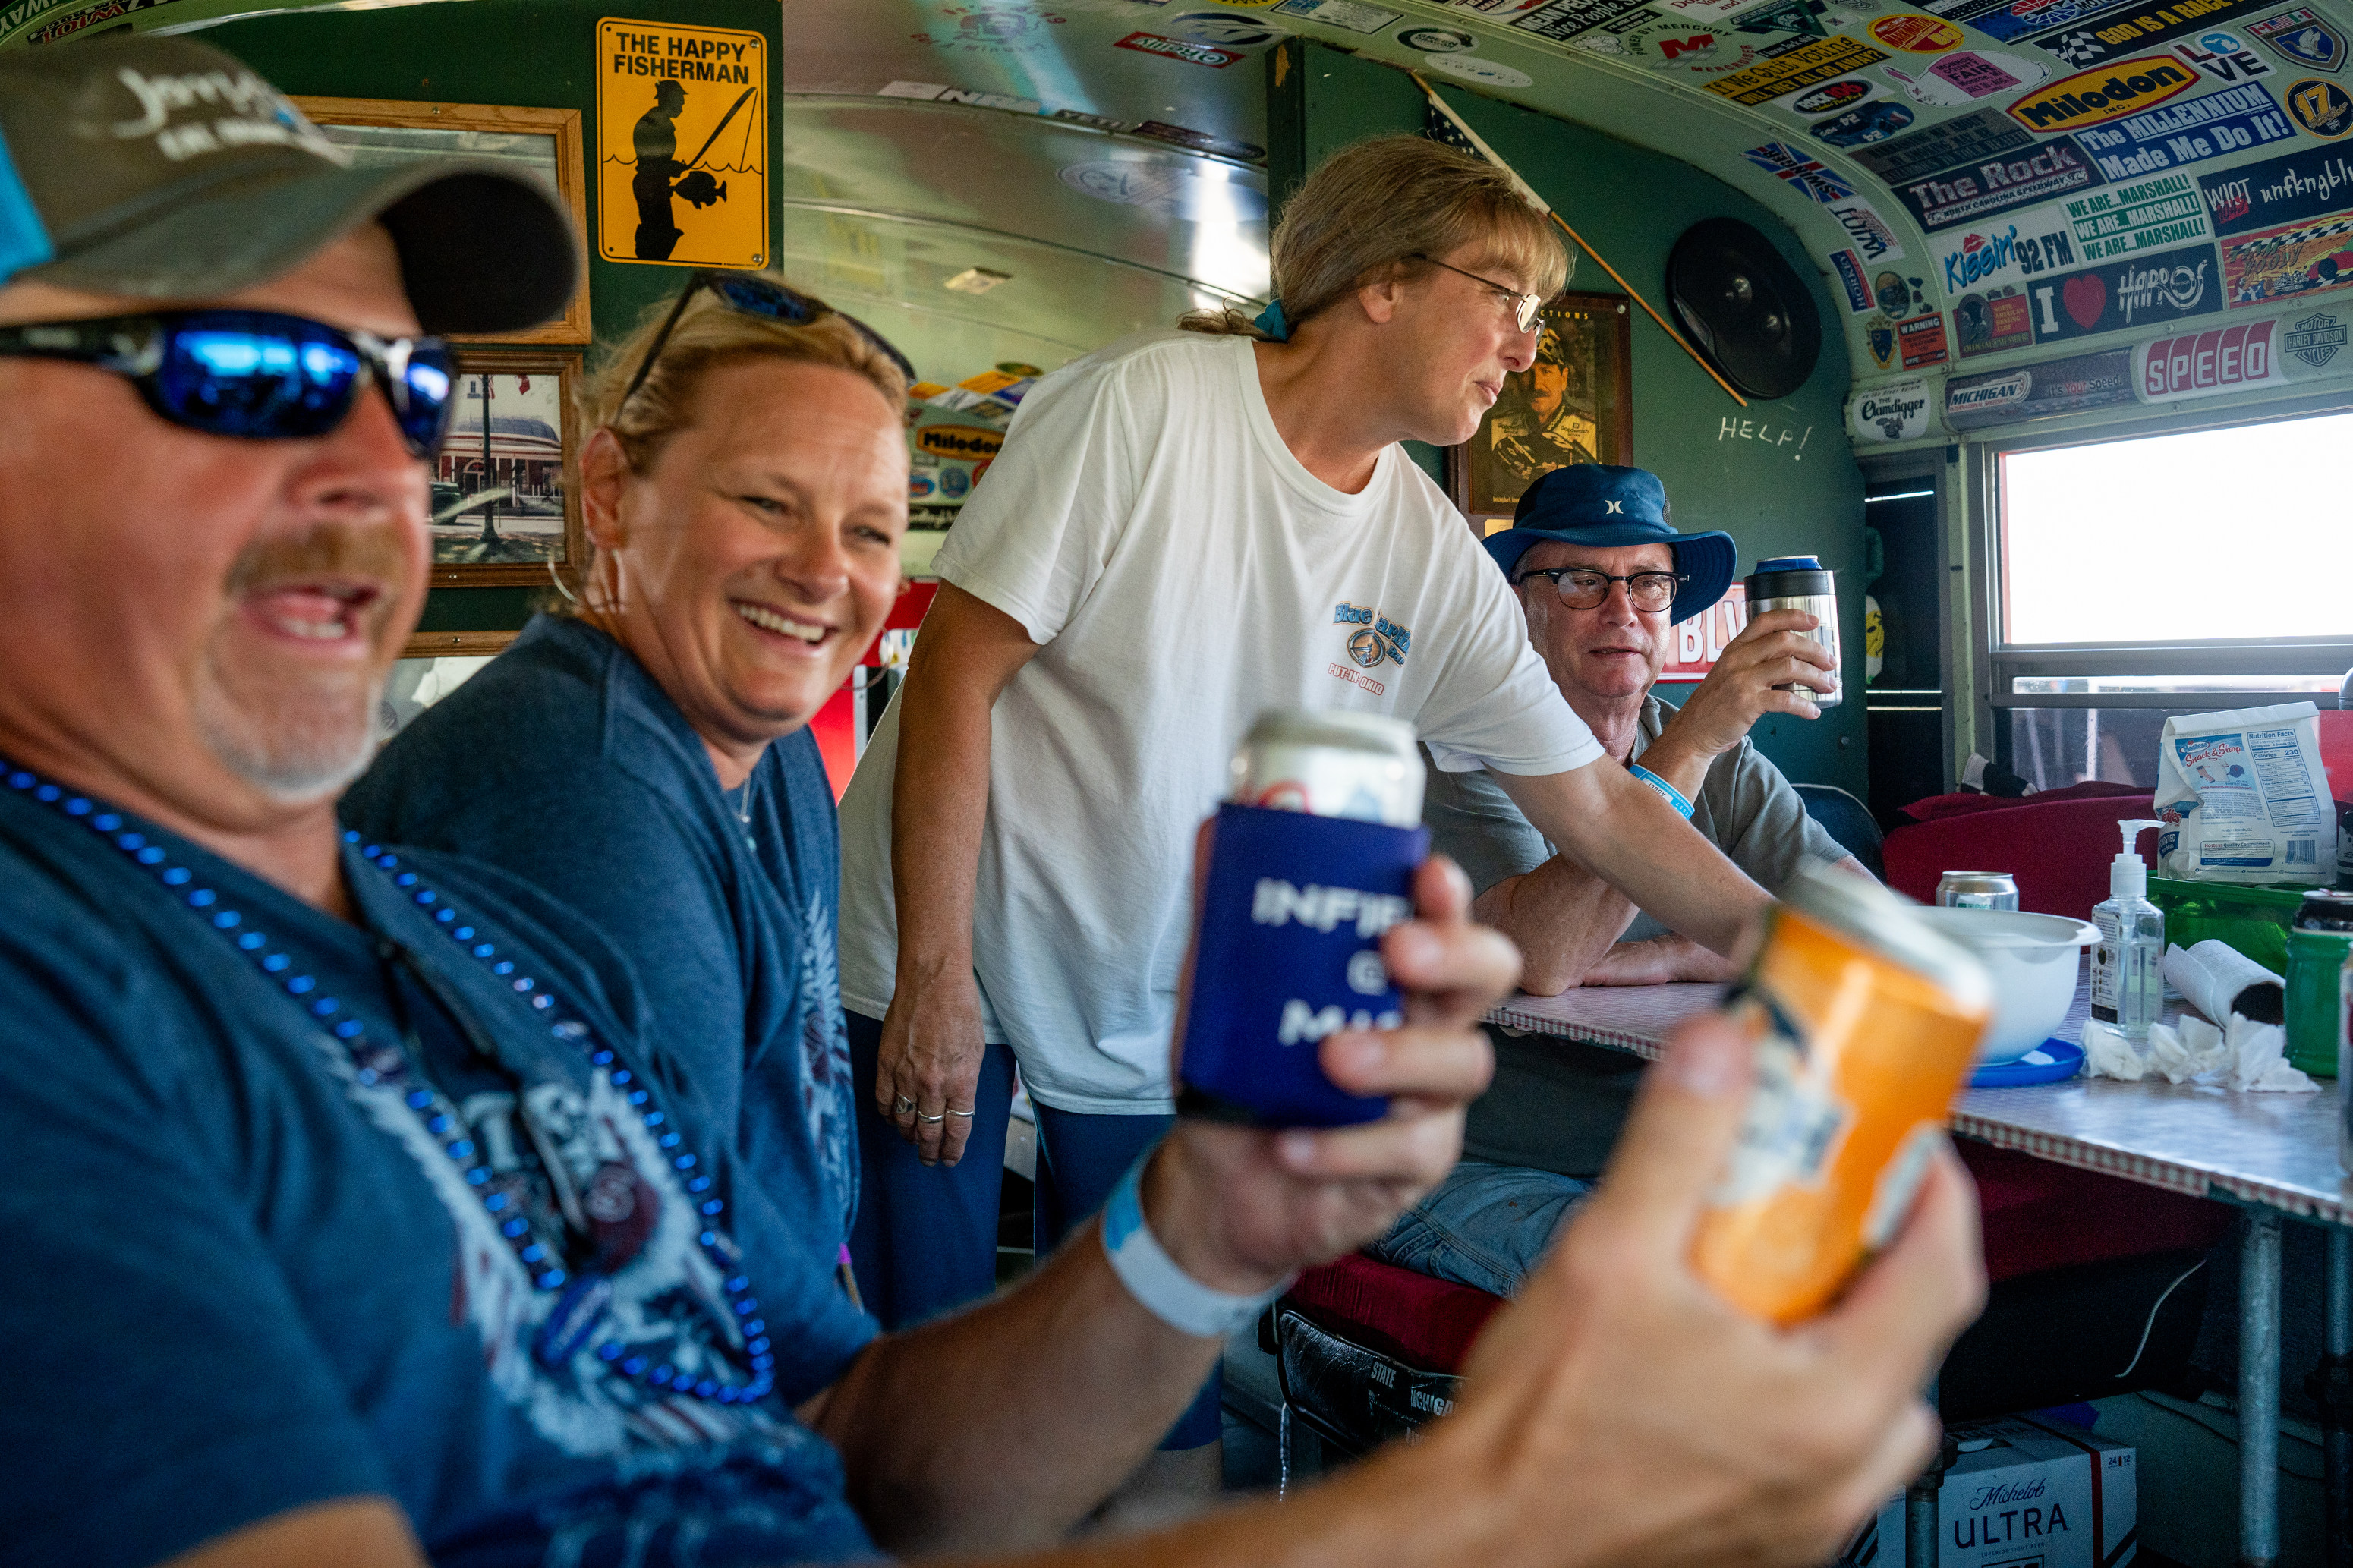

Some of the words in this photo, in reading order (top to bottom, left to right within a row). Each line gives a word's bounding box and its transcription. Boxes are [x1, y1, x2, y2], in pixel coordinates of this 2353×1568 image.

[1516, 7, 1564, 31] MEAN
[1540, 20, 1581, 39] Nice
[1568, 2, 1624, 27] People
[1658, 23, 1732, 37] MERCURY
[2096, 24, 2144, 45] GOD
[2133, 15, 2166, 33] IS
[2156, 10, 2183, 25] A
[616, 32, 660, 55] THE
[668, 37, 745, 62] HAPPY
[1928, 27, 1964, 46] 60
[613, 55, 750, 85] FISHERMAN
[1691, 45, 1755, 73] MERCRUISER
[1704, 79, 1731, 96] If
[1727, 70, 1756, 90] We
[1750, 53, 1799, 79] Quit
[1784, 36, 1866, 68] Voting
[1936, 56, 1974, 70] MONROE
[1942, 60, 1980, 74] COUNTY
[1948, 64, 1997, 81] FAIR
[1737, 87, 1770, 105] WILL
[1765, 77, 1799, 96] THEY
[1796, 70, 1825, 87] ALL
[1815, 61, 1838, 77] GO
[1835, 47, 1883, 74] AWAY?
[1797, 90, 1836, 111] ROCK
[1823, 81, 1864, 99] 106
[2019, 61, 2188, 128] Milodon
[2103, 102, 2131, 115] INC.
[2295, 82, 2331, 127] 17
[2078, 122, 2127, 152] The
[2125, 83, 2272, 140] MILLENNIUM
[2099, 144, 2170, 181] Made
[2171, 137, 2211, 166] Me
[2210, 123, 2253, 151] Do
[2248, 109, 2290, 143] It!
[1762, 149, 1837, 194] SWINGER
[1908, 176, 1979, 209] The
[1979, 144, 2080, 190] Rock
[1943, 205, 1971, 217] NORTH
[1973, 192, 2015, 208] CAROLINA
[2016, 177, 2065, 197] SPEEDWAY
[2203, 178, 2252, 212] WIOT
[2066, 201, 2090, 219] WE
[1827, 206, 1887, 260] WIOT
[2074, 220, 2097, 241] WE
[1944, 225, 2018, 294] Kissin'
[2016, 239, 2040, 275] 92
[2046, 230, 2077, 269] FM
[2083, 243, 2105, 261] WE
[2244, 241, 2307, 276] WOODY
[1837, 254, 1865, 308] HORKEY
[1539, 309, 1589, 320] CTIONS
[1995, 308, 2025, 318] AMERICAN
[2036, 286, 2059, 334] I
[2301, 316, 2330, 332] MOTOR
[1900, 316, 1940, 334] WARNING
[1997, 324, 2012, 332] CLUB
[2288, 332, 2311, 347] HARLEY
[2312, 327, 2344, 345] DAVIDSON
[2149, 341, 2266, 392] SPEED
[2302, 347, 2332, 361] CYCLES
[1951, 383, 2018, 405] MICHIGAN
[2046, 386, 2064, 398] It's
[2064, 381, 2087, 395] Your
[1862, 398, 1925, 421] Clamdigger
[1718, 417, 1813, 461] HELP!
[1333, 603, 1373, 625] Blue
[1679, 601, 1747, 663] BLV
[2248, 731, 2276, 740] Nutrition
[2277, 730, 2294, 738] Facts
[2185, 750, 2210, 767] Snack
[2219, 742, 2241, 755] Shop
[2162, 808, 2181, 823] ettes
[1371, 1361, 1397, 1389] STATE
[1410, 1389, 1454, 1417] ICHIGA
[2108, 1456, 2118, 1466] 24
[1969, 1477, 2048, 1510] Michelob
[1954, 1503, 2068, 1550] ULTRA
[1981, 1548, 2010, 1558] SUPERIOR
[2011, 1544, 2030, 1554] LIGHT
[2030, 1541, 2046, 1550] BEER
